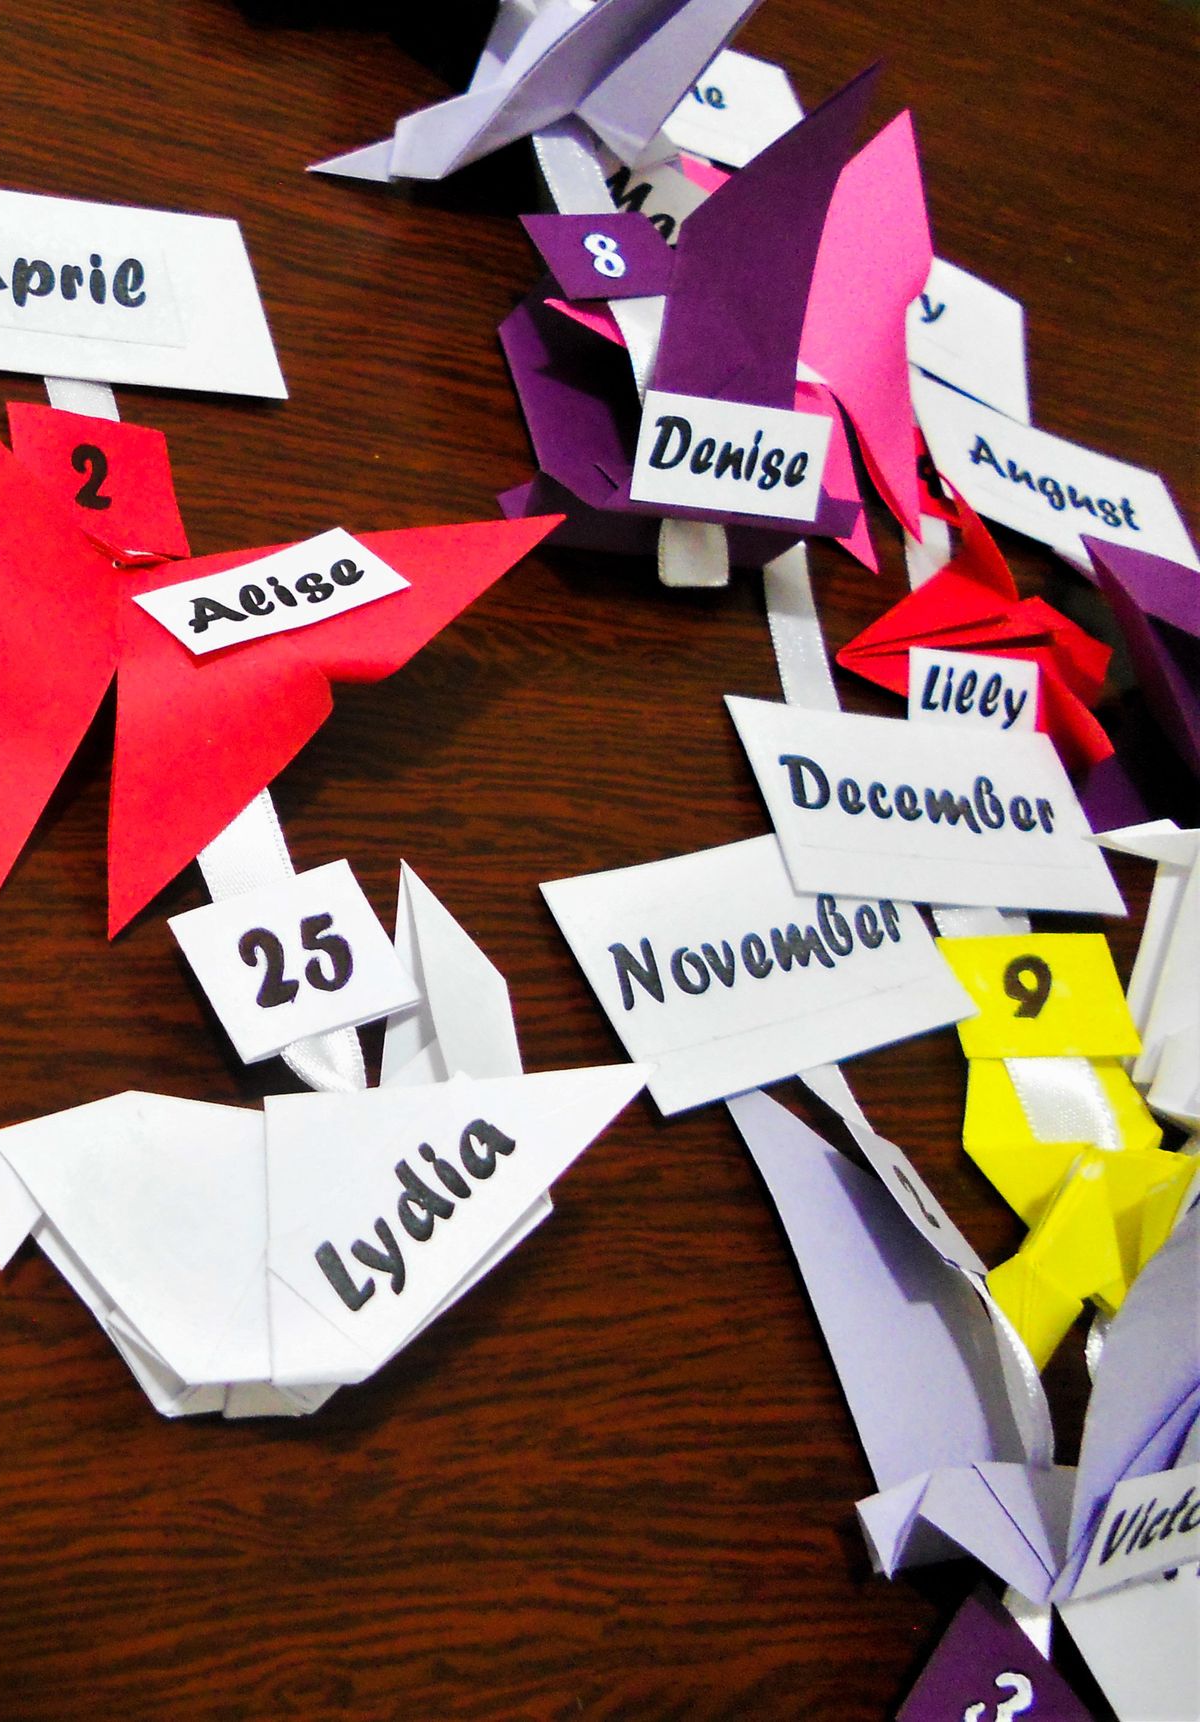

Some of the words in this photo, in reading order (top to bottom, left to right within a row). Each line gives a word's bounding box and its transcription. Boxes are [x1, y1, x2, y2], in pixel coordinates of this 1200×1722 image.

[582, 232, 626, 278] 8
[71, 444, 112, 511] 2
[649, 415, 810, 490] Denise
[968, 435, 1141, 532] August
[187, 556, 366, 635] Alise
[921, 663, 1028, 730] Lilly
[778, 753, 1056, 835] December
[238, 912, 355, 1009] 25
[607, 893, 902, 1011] November
[1003, 955, 1053, 1019] 9
[314, 1118, 516, 1313] Lydia
